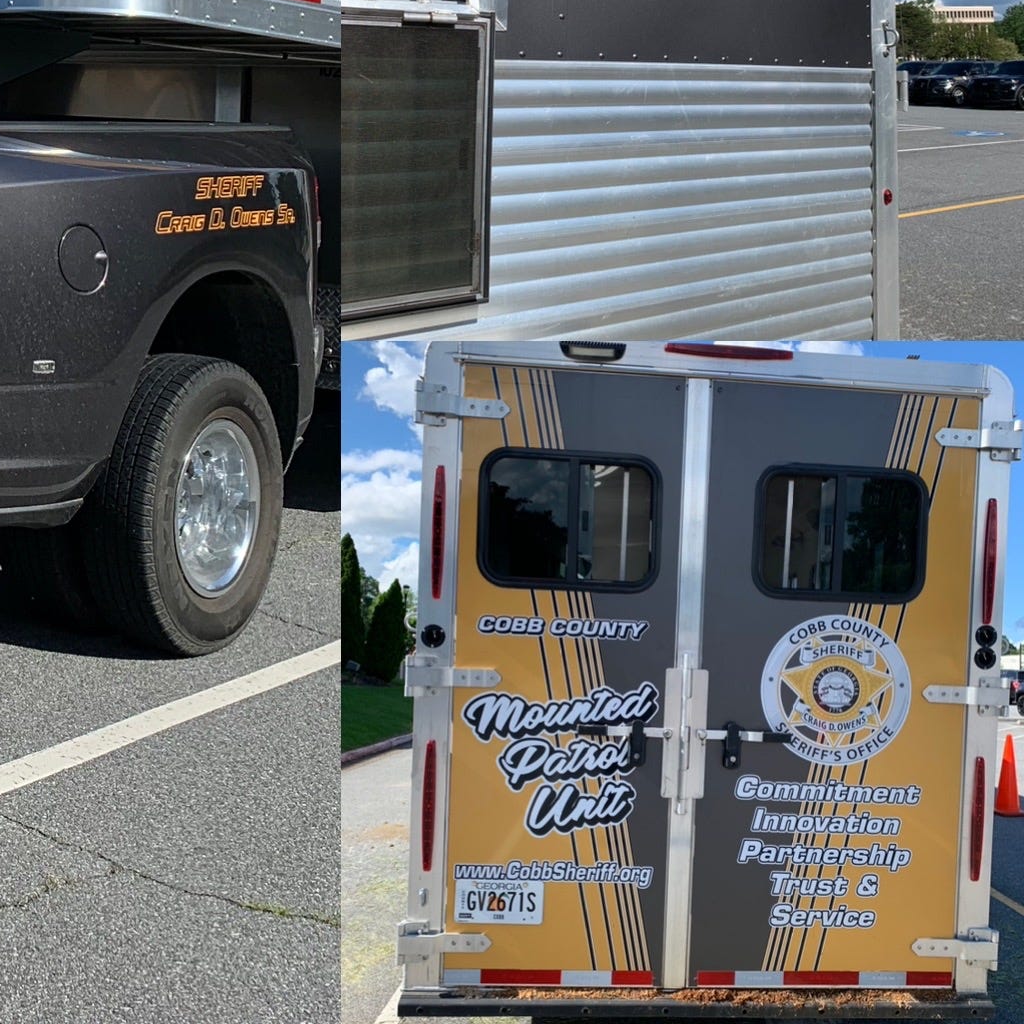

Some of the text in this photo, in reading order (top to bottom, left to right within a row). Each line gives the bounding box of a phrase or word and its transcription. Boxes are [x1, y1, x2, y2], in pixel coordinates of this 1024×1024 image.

[195, 175, 265, 200] SHERIFF
[208, 207, 226, 230] D.
[478, 615, 649, 641] COBB COUNTY
[789, 618, 890, 649] COBB COUNTY
[812, 644, 864, 660] SHERIFF
[464, 682, 657, 740] Mounted
[803, 712, 827, 730] CRAIG
[837, 714, 867, 732] OWENS
[846, 726, 894, 760] OFFICE
[735, 774, 922, 805] Commitment
[525, 783, 636, 837] Unit
[750, 806, 901, 835] Innovation
[737, 838, 912, 871] Partnership
[454, 861, 655, 889] www.CobbSheriff.org
[476, 882, 523, 890] GEORGIA
[770, 871, 879, 896] Trust &
[467, 890, 536, 913] GV2671S
[769, 904, 876, 929] Service
